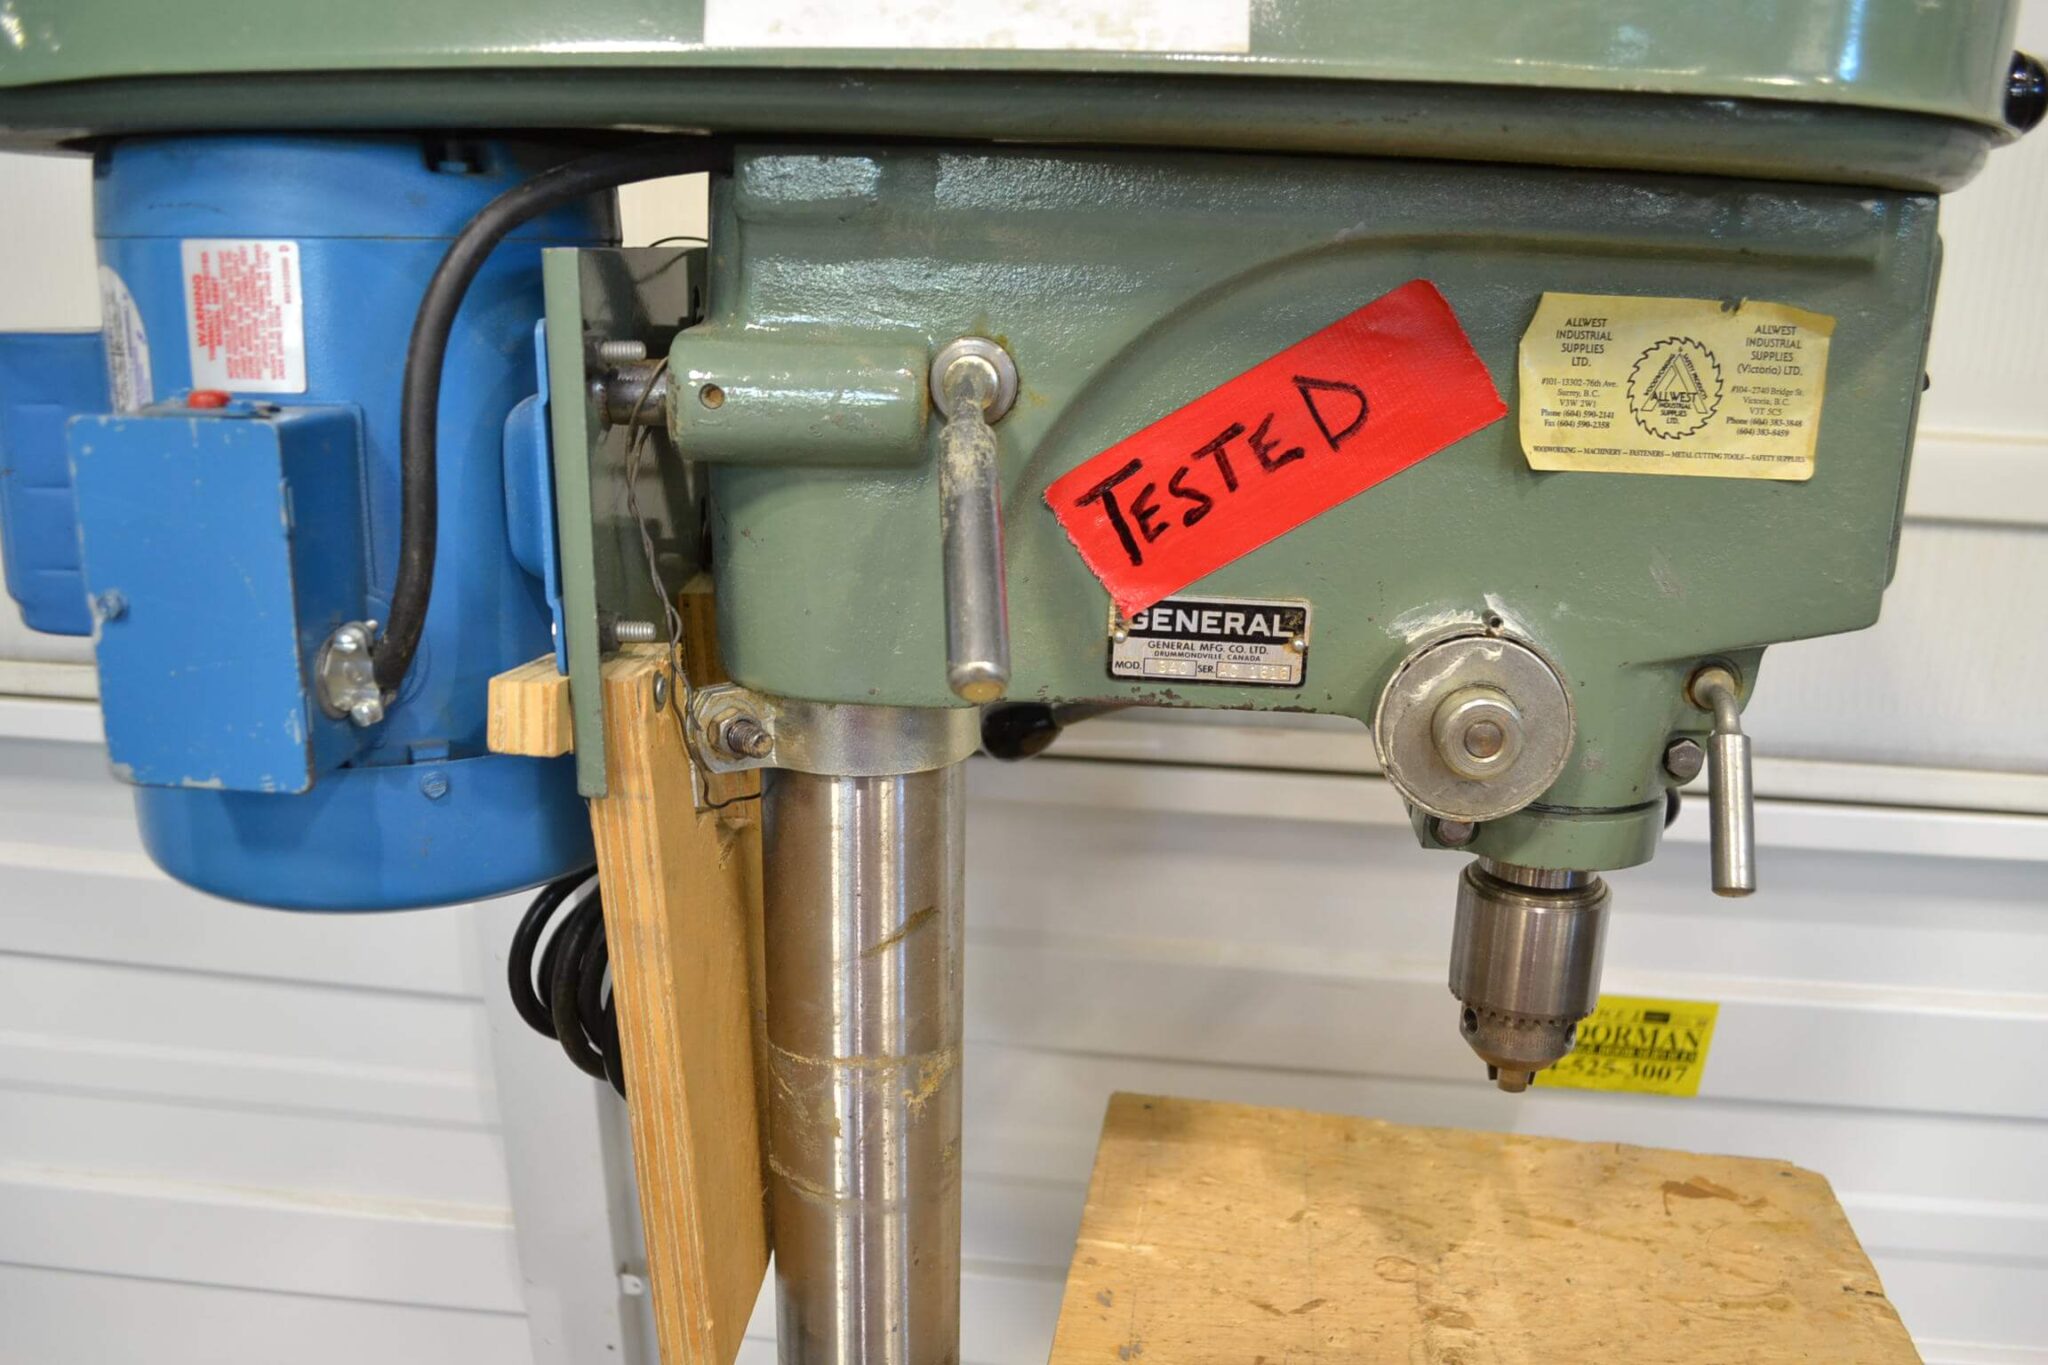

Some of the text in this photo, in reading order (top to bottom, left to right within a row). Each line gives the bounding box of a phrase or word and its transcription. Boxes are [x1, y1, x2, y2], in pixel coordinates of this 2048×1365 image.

[192, 273, 206, 347] WARNING
[1565, 318, 1608, 327] ALLWEST
[1556, 330, 1613, 341] INDUSTRIAL
[1754, 325, 1797, 335] ALLWEST
[1561, 342, 1605, 354] SUPPLIES
[1746, 338, 1802, 349] INDUSTRIAL
[1571, 356, 1591, 367] LTD.
[1751, 351, 1793, 362] SUPPLIES
[1737, 363, 1803, 376] (Victoria) LTD.
[1583, 389, 1600, 398] B.C.
[1650, 391, 1698, 402] ALLWEST
[1770, 386, 1794, 397] Bridge
[1541, 409, 1561, 417] Phone
[1563, 410, 1581, 418] (604)
[1544, 419, 1555, 427] Fax
[1557, 420, 1575, 428] (604)
[1726, 416, 1748, 425] Phone
[1074, 375, 1370, 567] TESTED
[1130, 607, 1294, 638] GENERAL
[1147, 640, 1269, 655] GENERAL MFG. CO. LTD.
[1227, 653, 1261, 662] CANADA
[1114, 660, 1142, 670] MOD.
[1198, 662, 1216, 673] SER.
